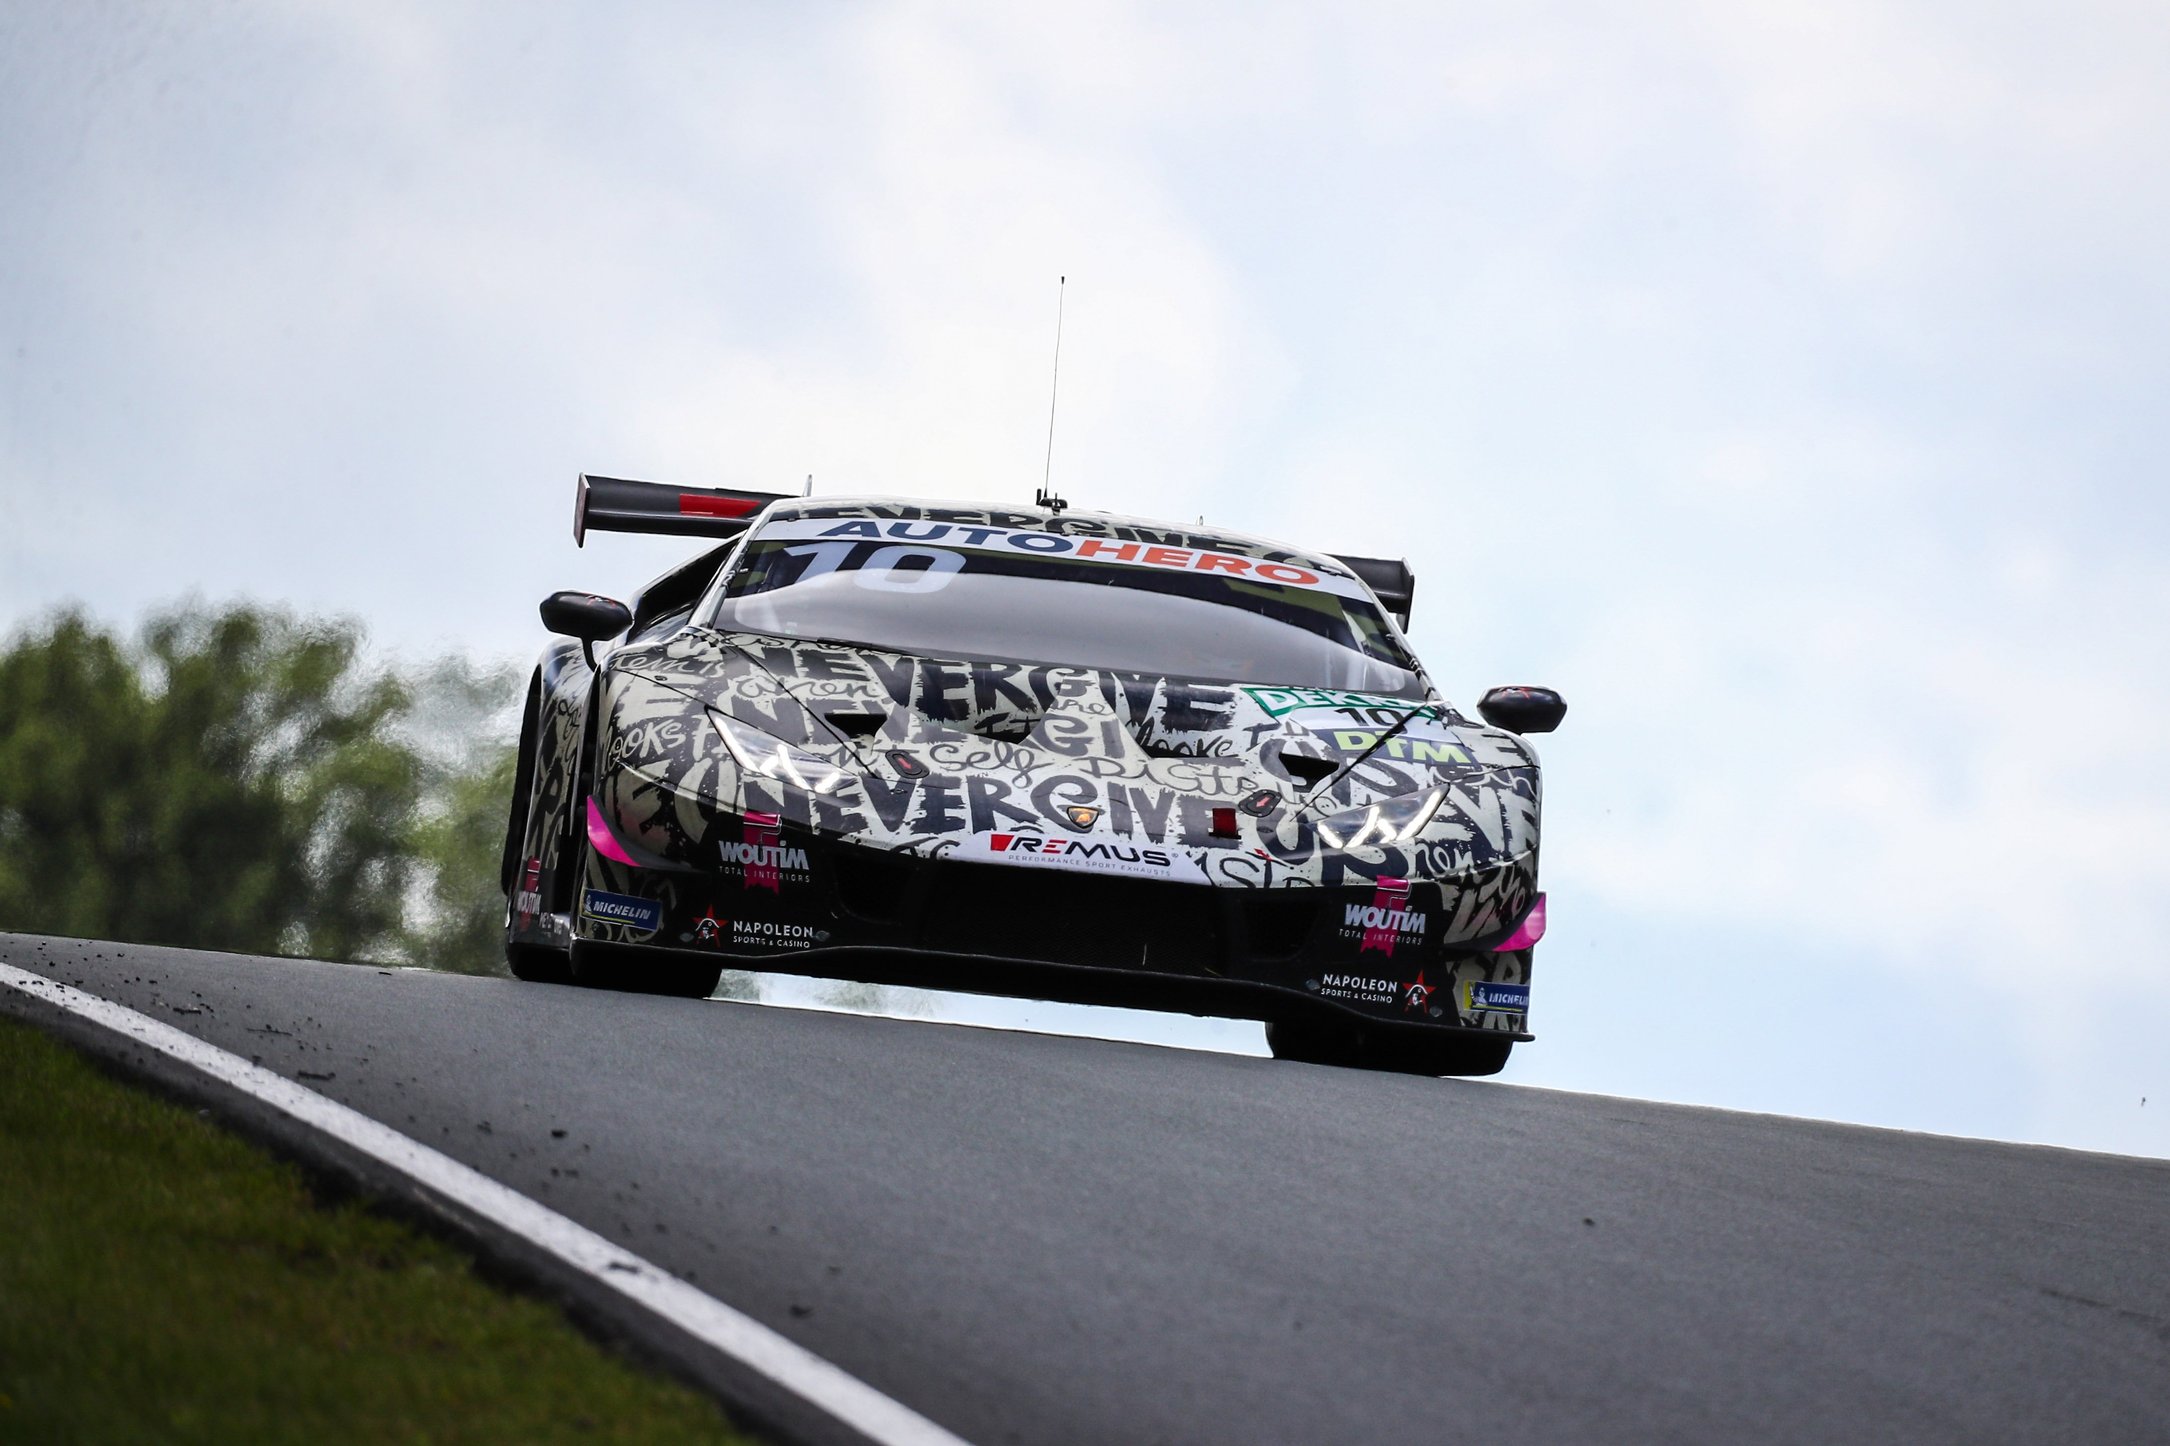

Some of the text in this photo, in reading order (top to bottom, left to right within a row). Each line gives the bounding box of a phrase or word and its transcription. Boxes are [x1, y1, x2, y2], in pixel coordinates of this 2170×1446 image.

[784, 541, 967, 594] 10
[1333, 730, 1472, 764] DTM
[1010, 836, 1171, 867] REMUS
[719, 865, 810, 883] TOTAL INTERIORS
[1008, 854, 1171, 877] PERFORMANCE SPORT EXHAUSTS
[593, 901, 652, 920] MICHELIN
[733, 920, 813, 938] NAPOLEON
[1338, 929, 1423, 946] TOTAL INTERIORS
[732, 935, 766, 946] SPORTS
[776, 939, 811, 949] CASINO
[1322, 973, 1398, 993] NAPOLEON
[1320, 987, 1351, 1000] SPORTS
[1360, 992, 1393, 1004] CASINO
